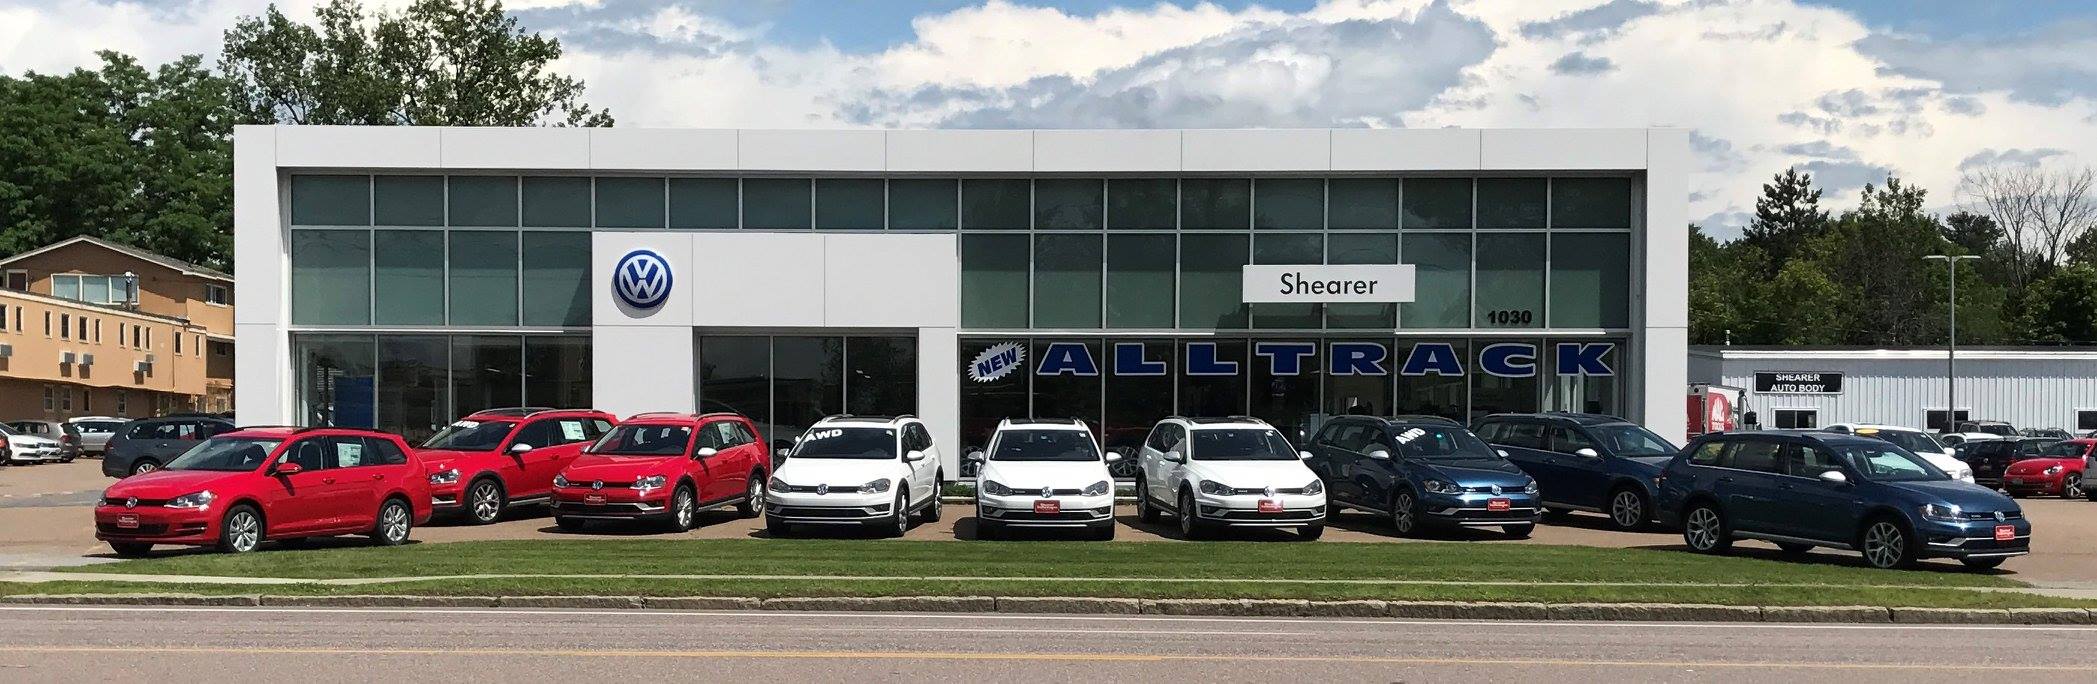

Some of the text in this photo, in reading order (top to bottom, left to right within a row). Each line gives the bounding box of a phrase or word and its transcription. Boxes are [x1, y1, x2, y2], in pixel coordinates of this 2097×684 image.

[615, 251, 672, 307] VW
[1279, 272, 1378, 295] Shearer
[1487, 310, 1532, 325] 1030
[977, 346, 1017, 378] NEW
[1035, 342, 1617, 377] ALLTRACK
[1775, 373, 1821, 382] SHEARER
[1770, 384, 1826, 392] AUTO BODY
[804, 429, 843, 442] AWD
[1395, 428, 1426, 444] AWD
